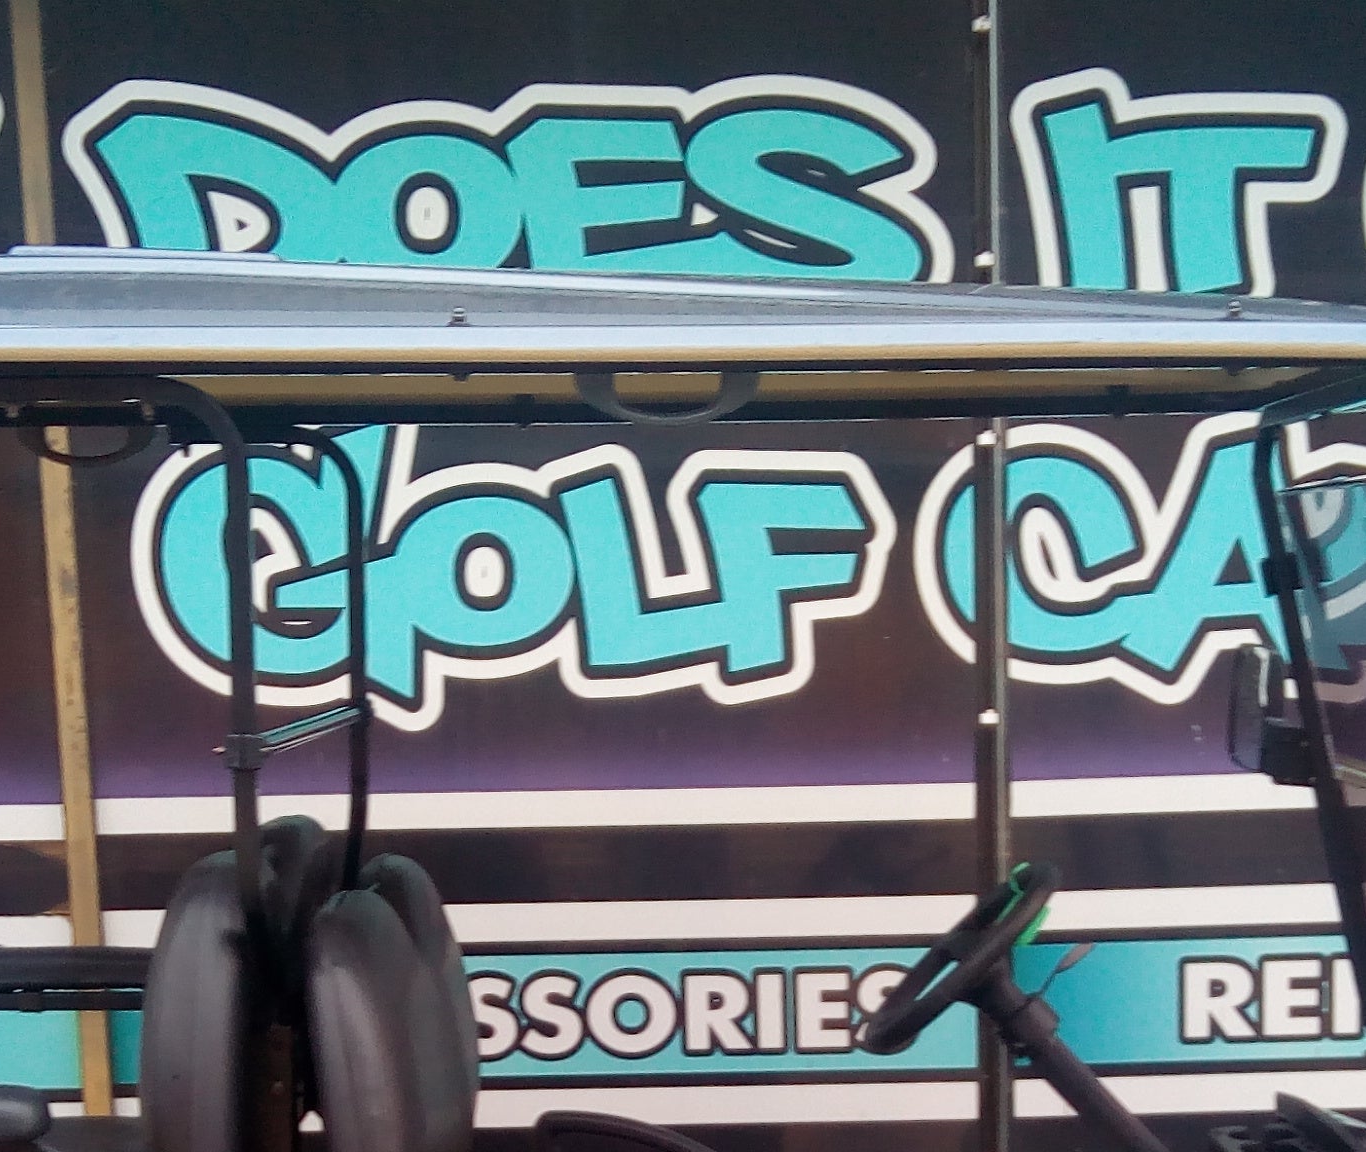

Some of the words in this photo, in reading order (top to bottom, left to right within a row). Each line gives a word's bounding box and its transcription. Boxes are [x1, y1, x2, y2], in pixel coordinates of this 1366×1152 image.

[81, 98, 935, 284] DOES
[1031, 92, 1329, 294] IT
[150, 424, 877, 704] GOLF
